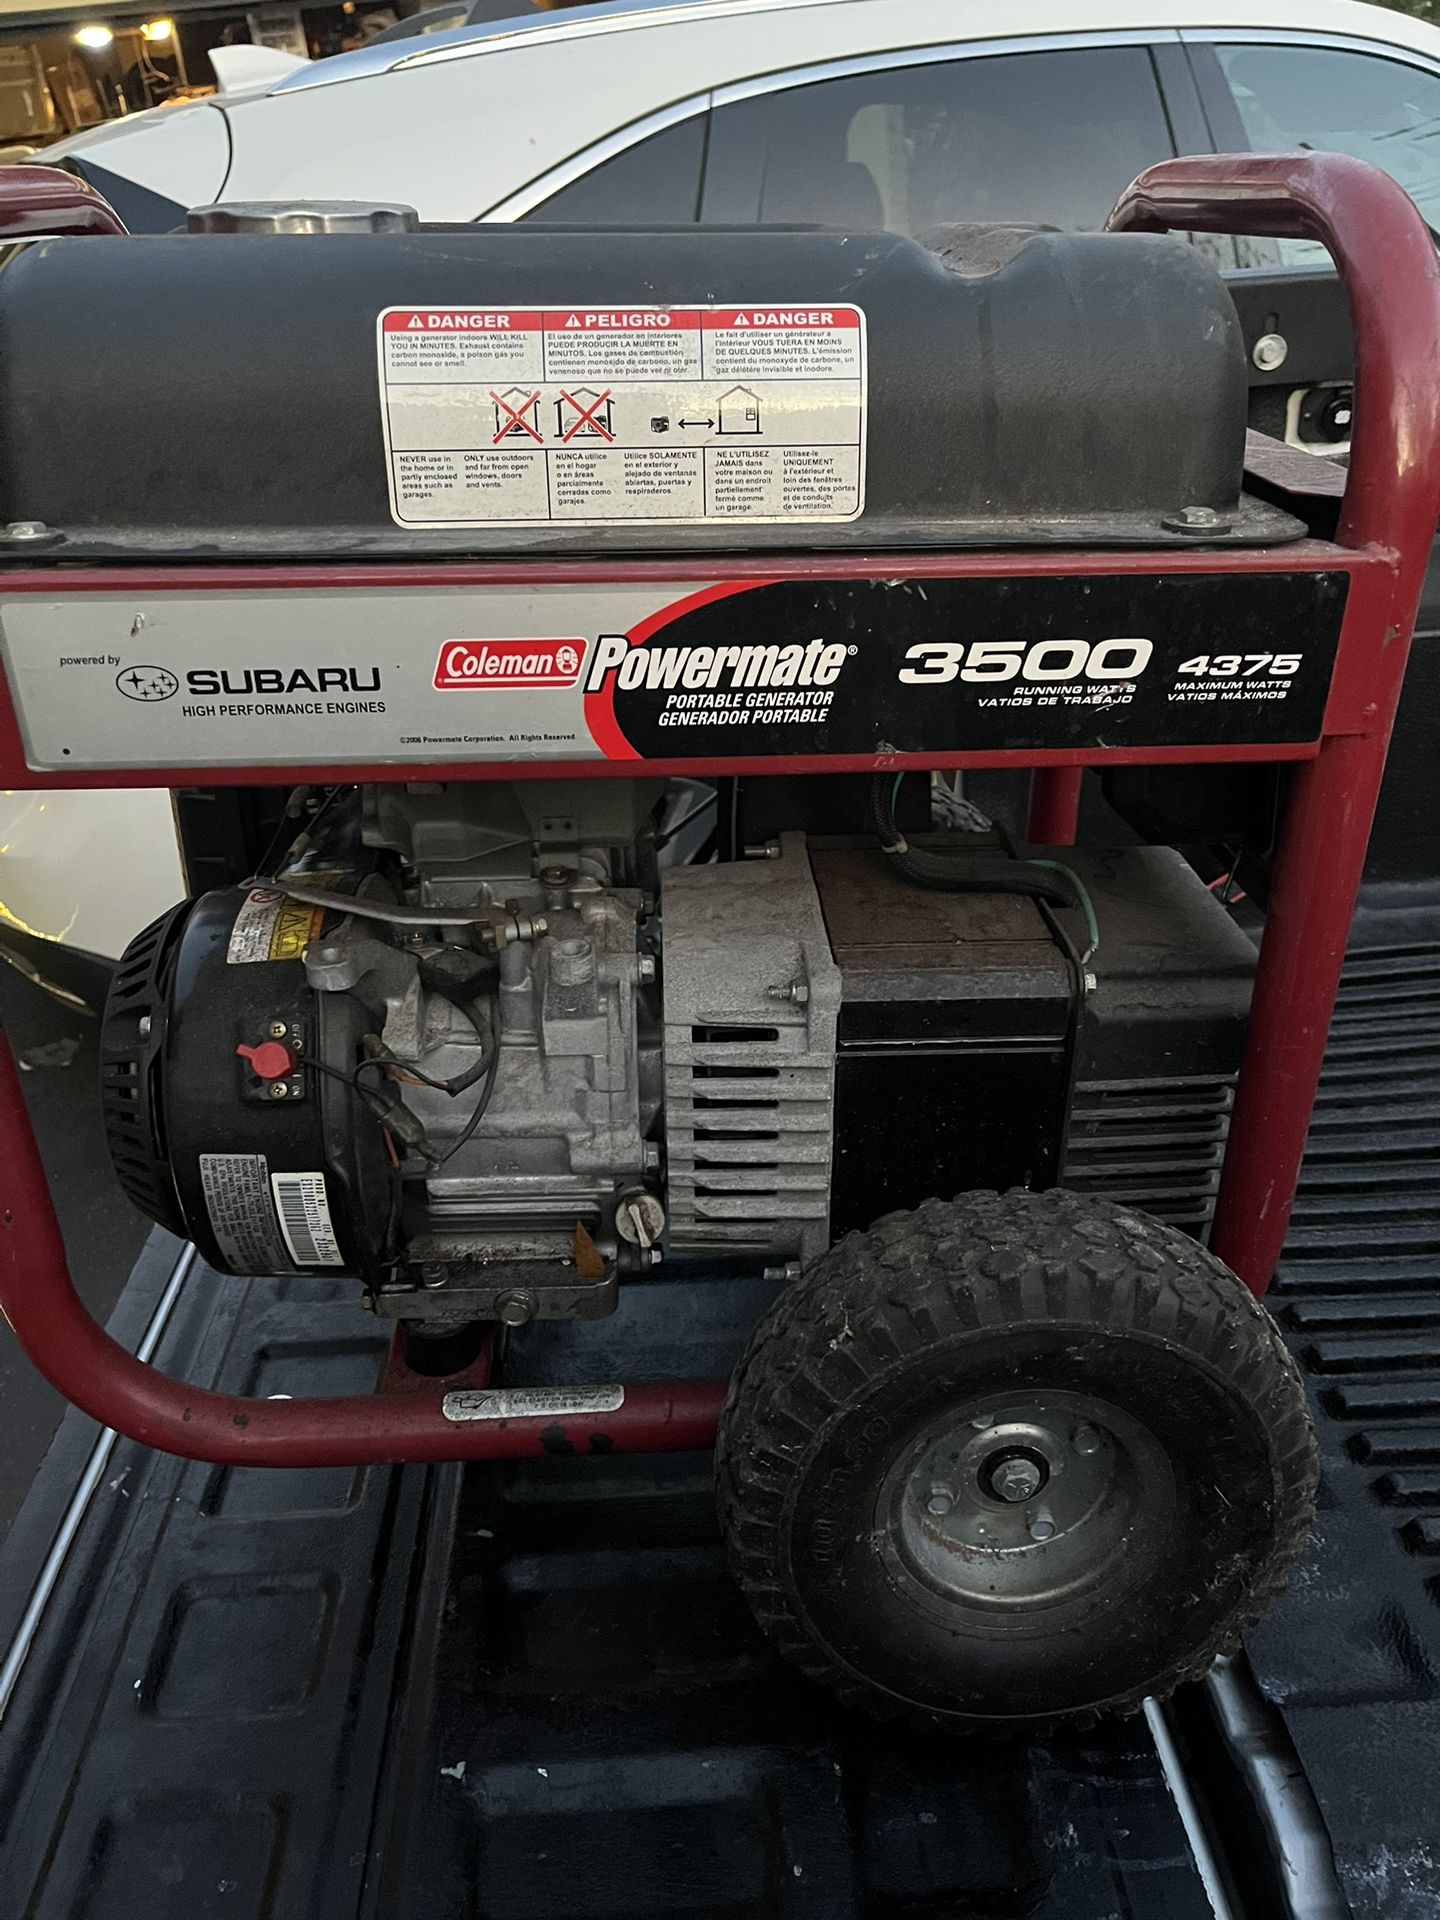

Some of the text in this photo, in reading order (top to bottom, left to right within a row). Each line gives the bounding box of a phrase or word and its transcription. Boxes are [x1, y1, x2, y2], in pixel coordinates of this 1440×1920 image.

[428, 315, 510, 328] DANGER
[585, 314, 671, 327] PELIGRO
[753, 312, 833, 325] DANGER
[60, 655, 121, 667] powered by
[446, 646, 553, 678] Coleman
[898, 638, 1153, 684] 3500
[1177, 653, 1303, 676] 4375
[186, 667, 382, 695] SUBARU
[1174, 680, 1292, 690] MAXIMUM WATTS
[1013, 684, 1137, 696] RUNNING WATTS
[1167, 692, 1217, 701] VATIOS
[666, 691, 833, 709] PORTABLE GENERATOR
[978, 694, 1133, 707] VATIOS DE TRABAJO
[182, 702, 386, 718] HIGH PERFORMANCE ENGINES
[659, 708, 828, 726] GENERADOR PORTABLE
